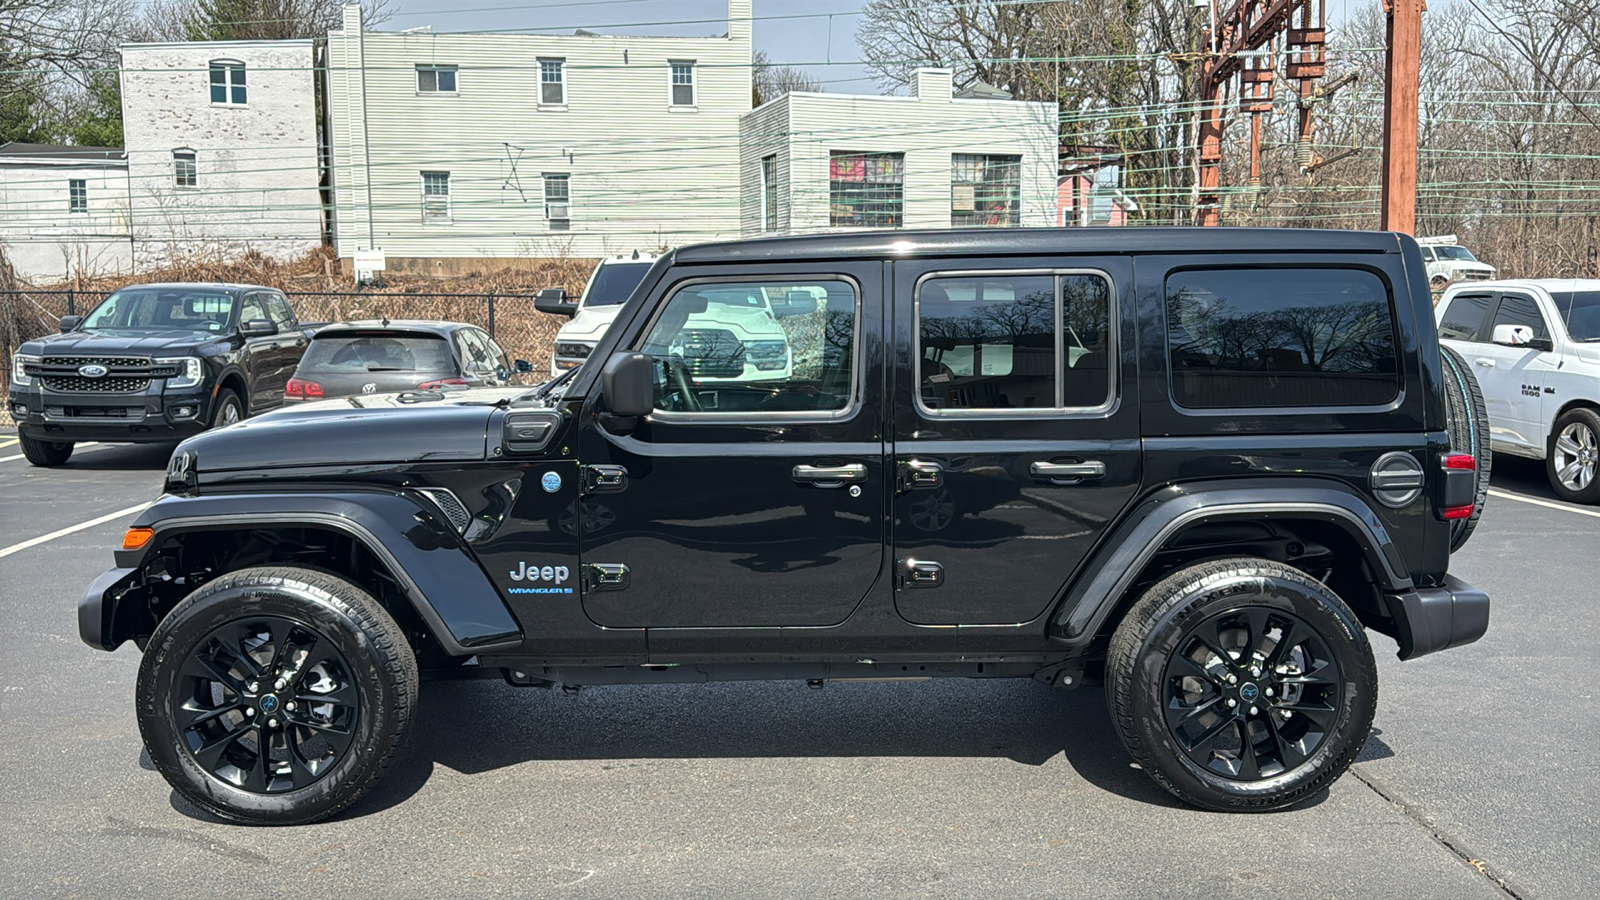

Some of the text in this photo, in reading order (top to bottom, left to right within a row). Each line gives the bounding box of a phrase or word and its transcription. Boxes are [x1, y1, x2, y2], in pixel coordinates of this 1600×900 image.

[509, 561, 569, 585] Jeep
[240, 591, 292, 600] All-Weather
[1176, 584, 1246, 620] NEXEN
